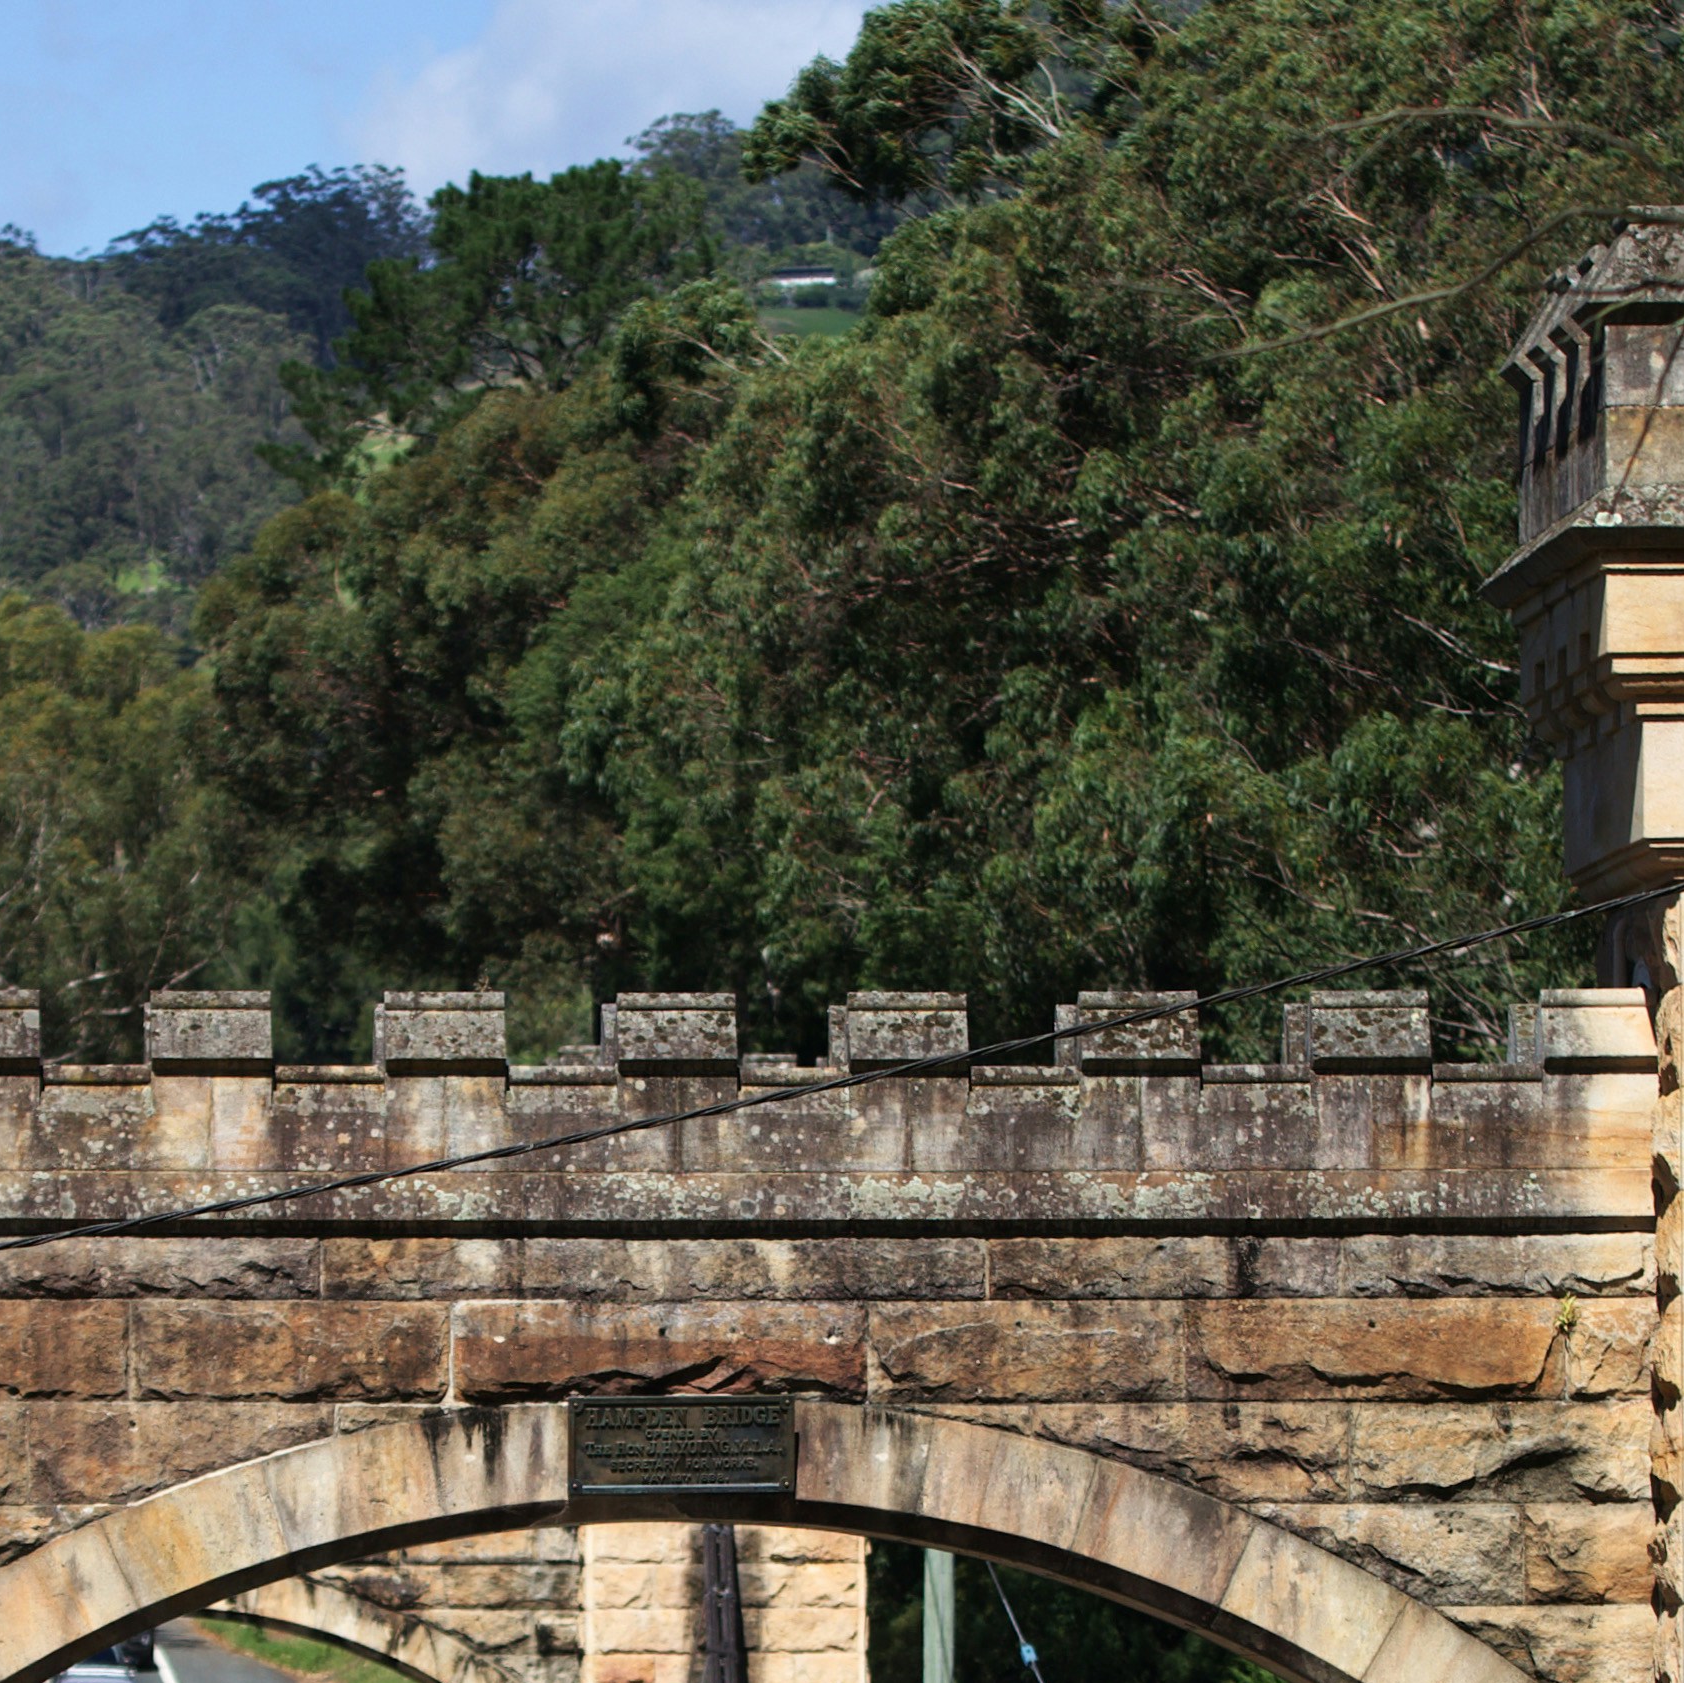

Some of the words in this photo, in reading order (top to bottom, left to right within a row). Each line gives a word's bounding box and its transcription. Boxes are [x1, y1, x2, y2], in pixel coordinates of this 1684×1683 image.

[585, 1407, 688, 1429] HAMPDEN
[702, 1406, 781, 1428] BRIDGE
[645, 1428, 695, 1440] OPENED
[700, 1427, 718, 1440] BY
[610, 1458, 679, 1473] SECRETARY
[685, 1458, 710, 1472] FOR
